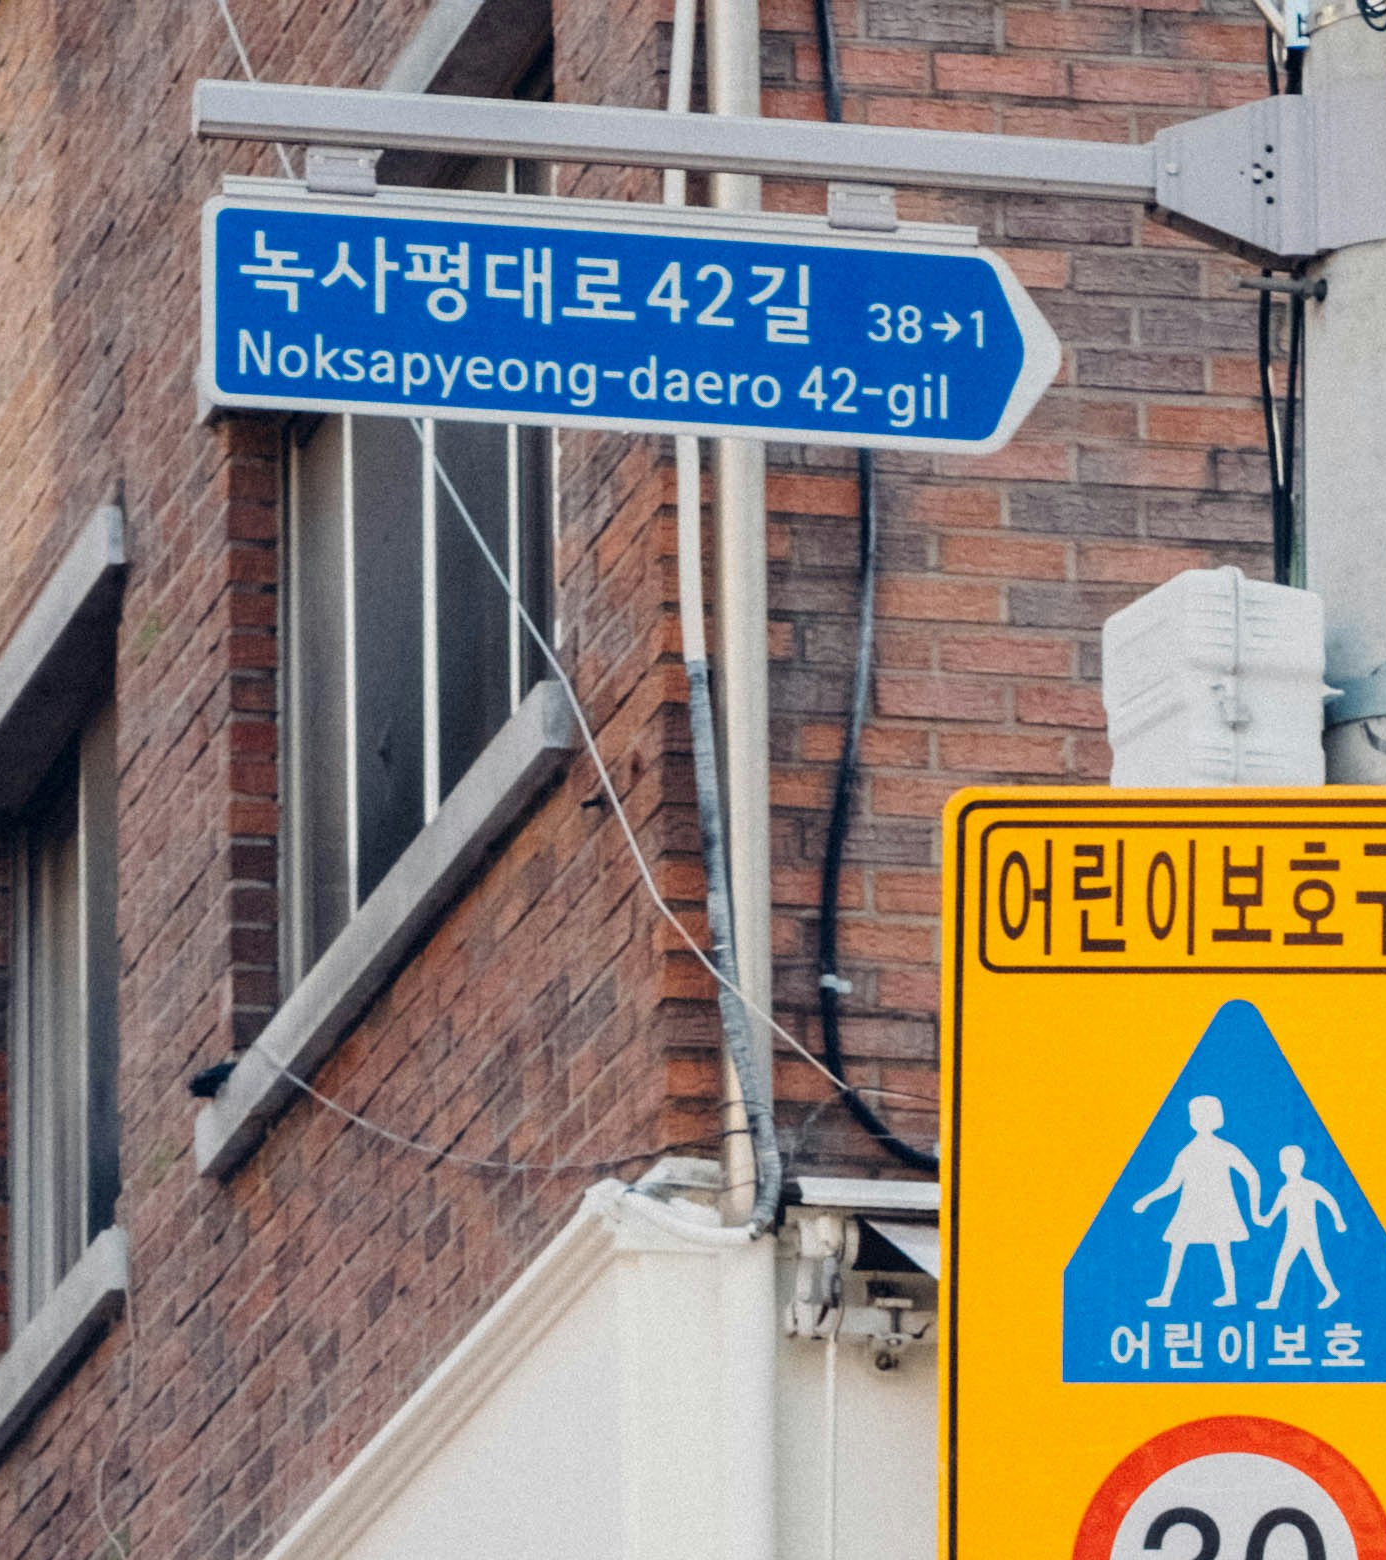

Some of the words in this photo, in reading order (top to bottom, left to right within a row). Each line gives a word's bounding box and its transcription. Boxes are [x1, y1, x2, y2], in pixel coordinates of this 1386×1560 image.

[237, 328, 782, 408] Noksapyeong-daero
[799, 365, 951, 427] 42-gil
[1109, 1320, 1367, 1370] 어린이보호
